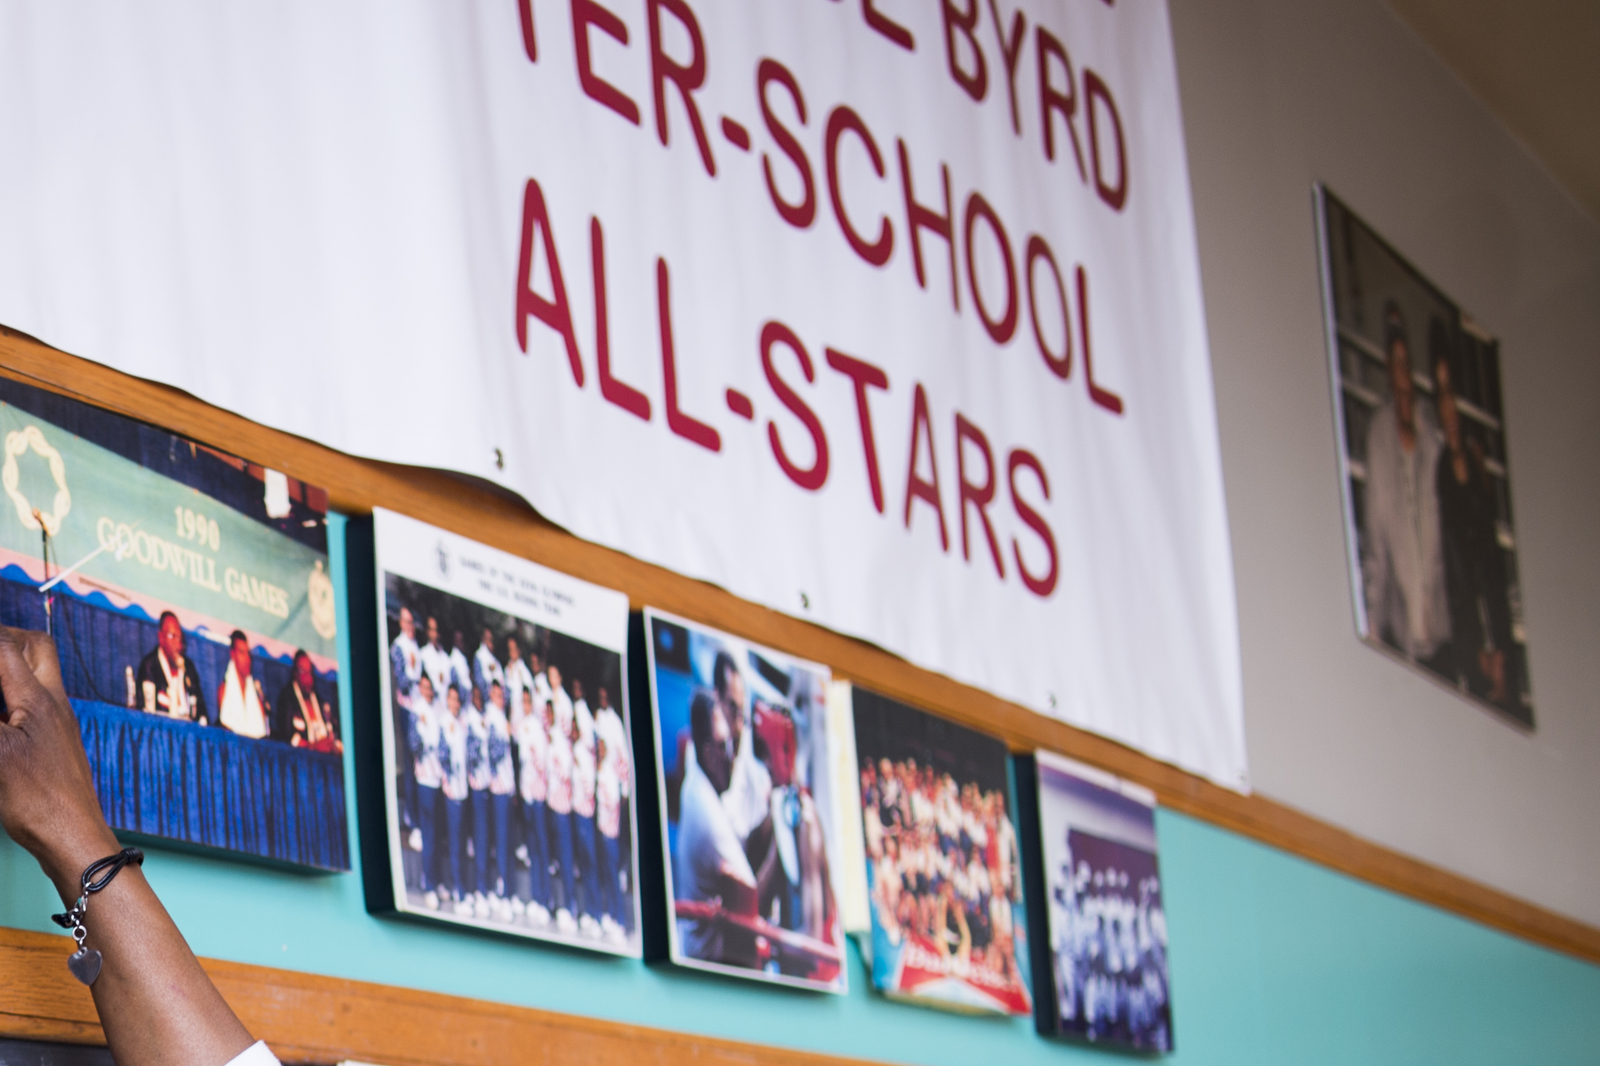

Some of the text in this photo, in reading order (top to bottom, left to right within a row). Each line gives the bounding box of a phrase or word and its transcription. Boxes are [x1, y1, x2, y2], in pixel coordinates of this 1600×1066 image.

[939, 0, 1129, 213] BYRD
[515, 177, 1061, 599] ALL-STARS
[97, 516, 289, 619] GOODWILL GAMES
[175, 506, 221, 551] 1990
